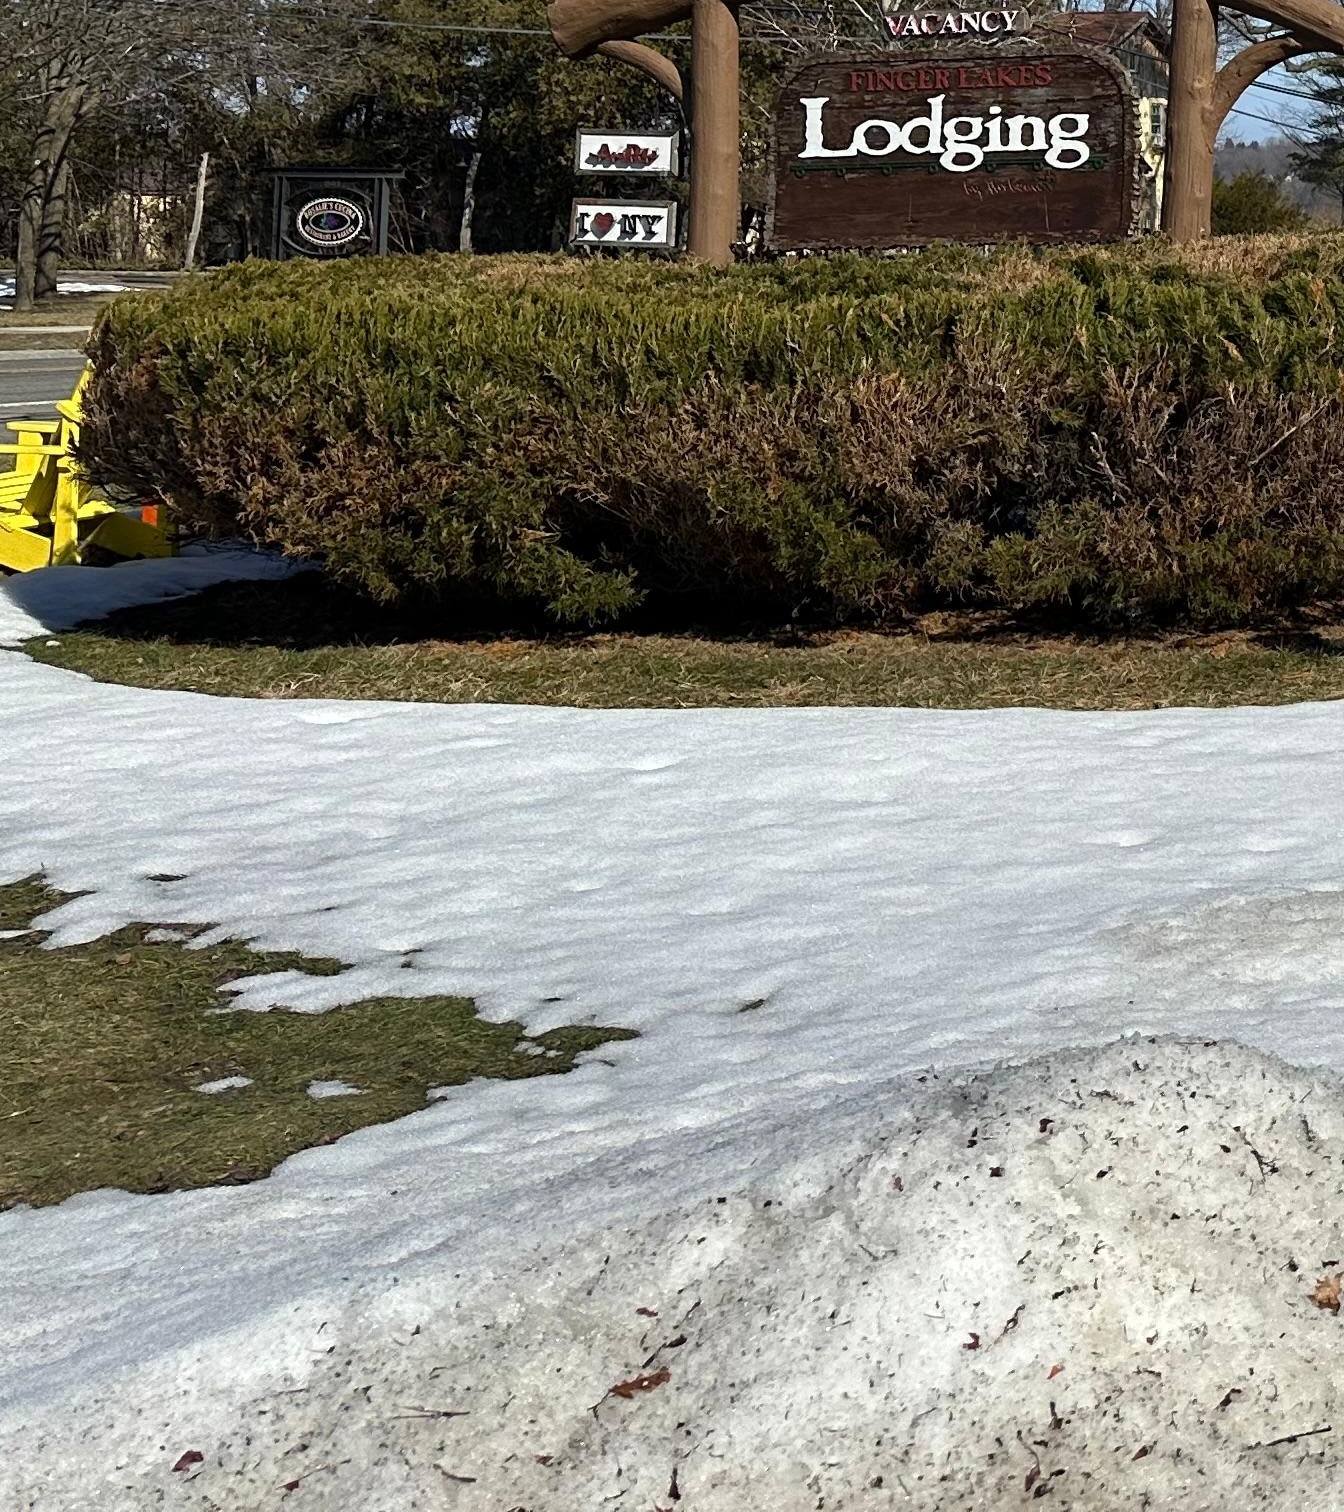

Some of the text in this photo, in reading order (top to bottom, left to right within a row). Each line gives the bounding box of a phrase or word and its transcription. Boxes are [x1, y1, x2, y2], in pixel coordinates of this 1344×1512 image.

[885, 10, 1019, 36] VACANCY
[850, 63, 1053, 92] FINGER LAKES
[797, 93, 1091, 173] Lodging
[577, 212, 664, 237] I NY
